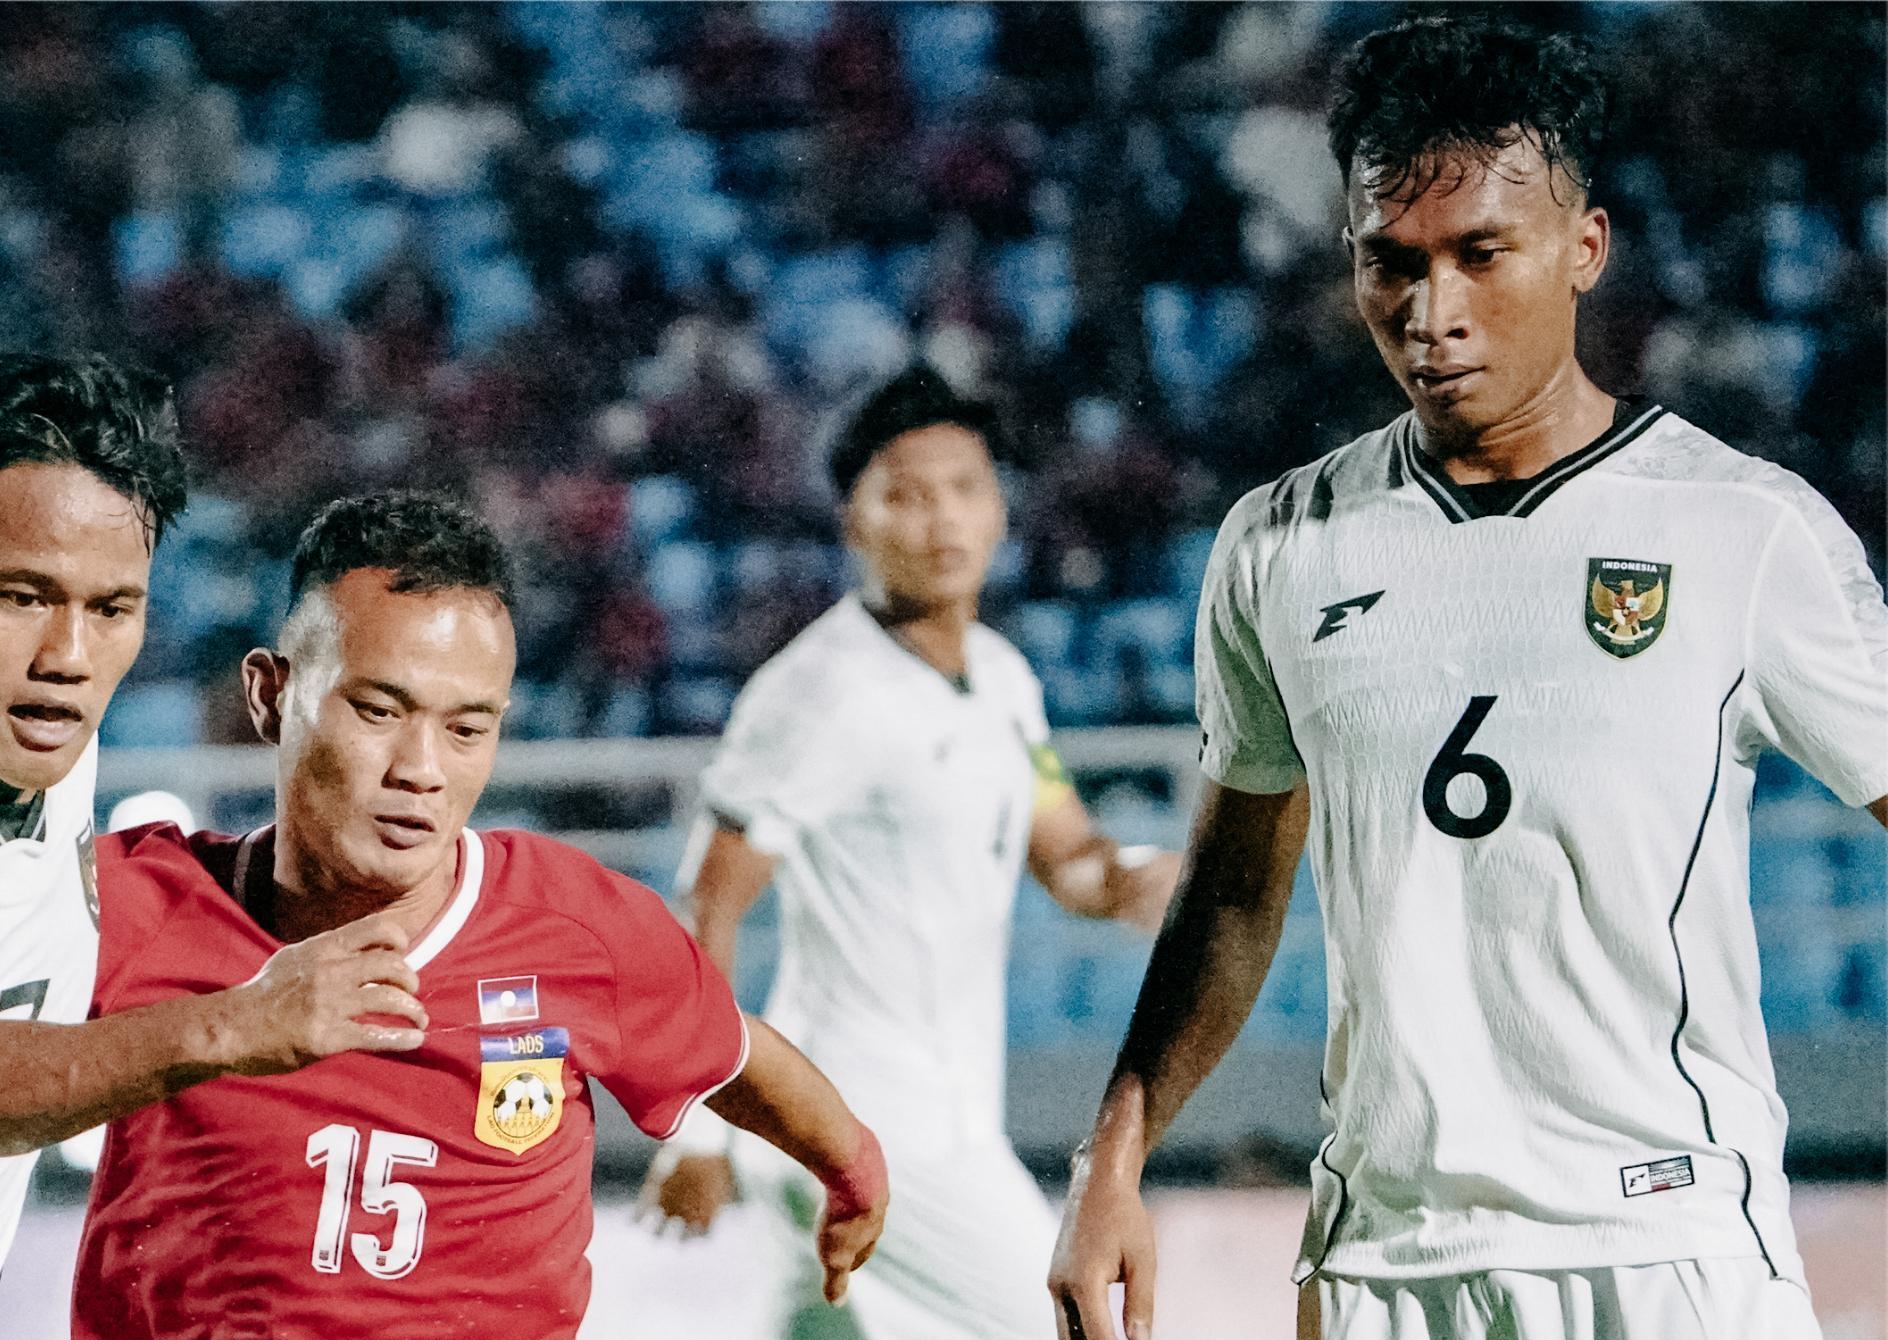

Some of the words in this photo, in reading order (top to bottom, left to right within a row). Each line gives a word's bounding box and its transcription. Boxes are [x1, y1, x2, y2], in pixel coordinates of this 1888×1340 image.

[1602, 561, 1658, 573] INDONESIA
[1423, 695, 1512, 840] 6
[507, 1034, 544, 1055] LAOS
[305, 1123, 439, 1280] 15
